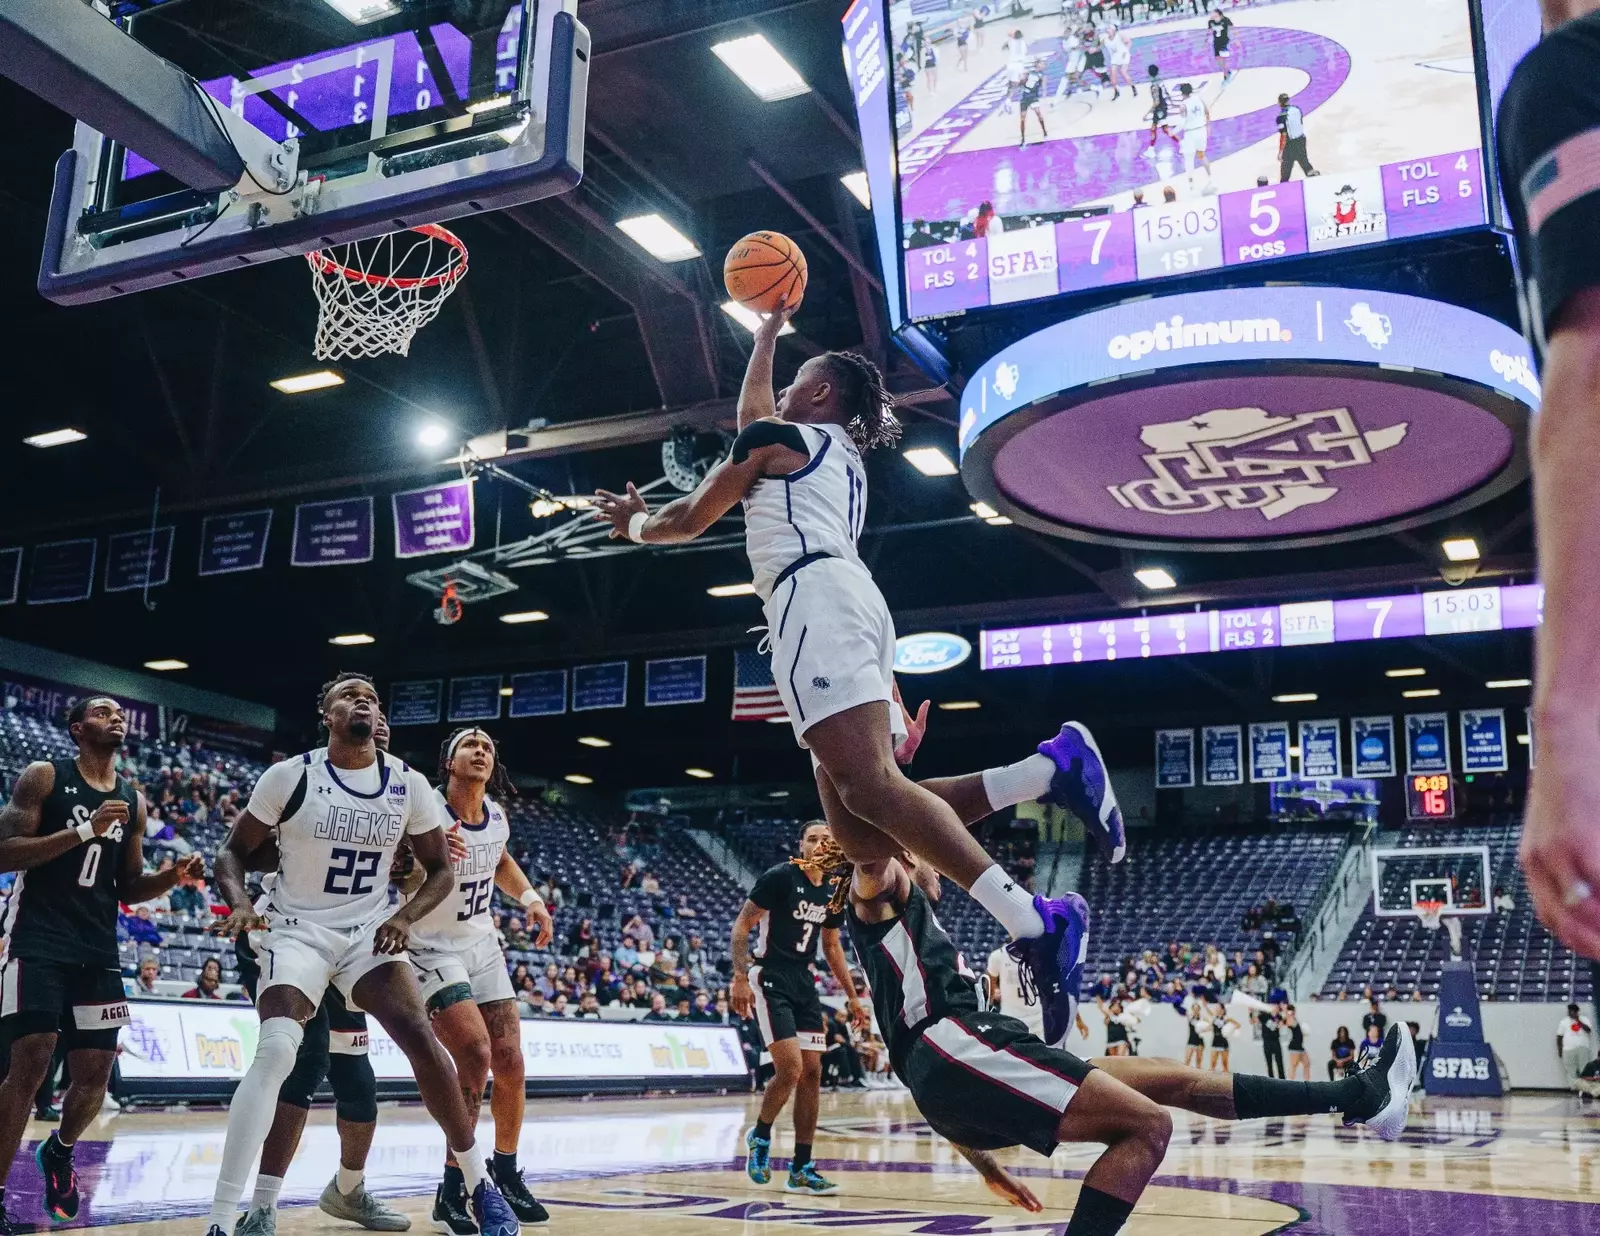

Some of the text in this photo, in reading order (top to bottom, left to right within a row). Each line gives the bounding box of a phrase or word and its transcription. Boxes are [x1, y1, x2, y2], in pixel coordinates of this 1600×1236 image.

[1399, 154, 1467, 182] TOL 4
[1402, 180, 1472, 208] FLS 5
[1141, 206, 1219, 243] 15:03
[1250, 190, 1281, 237] 5
[923, 242, 977, 267] TOL 4
[1082, 219, 1112, 265] 7
[1239, 240, 1286, 261] POSS
[992, 251, 1039, 277] SFA
[1159, 246, 1203, 271] 1ST
[924, 263, 979, 290] FLS 2
[1431, 593, 1495, 614] 15:03
[1223, 610, 1273, 628] TOL 4
[1366, 600, 1393, 639] 7
[1225, 628, 1274, 647] FLS 2
[900, 643, 950, 666] Ford
[1415, 776, 1448, 792] 15:03
[1424, 790, 1446, 814] 16
[66, 804, 124, 843] Ste
[314, 805, 402, 847] JACKS
[78, 843, 102, 888] 0
[323, 847, 383, 895] 22
[457, 877, 492, 921] 32
[792, 900, 827, 924] State
[796, 922, 814, 953] 3
[1432, 1057, 1477, 1079] SFA
